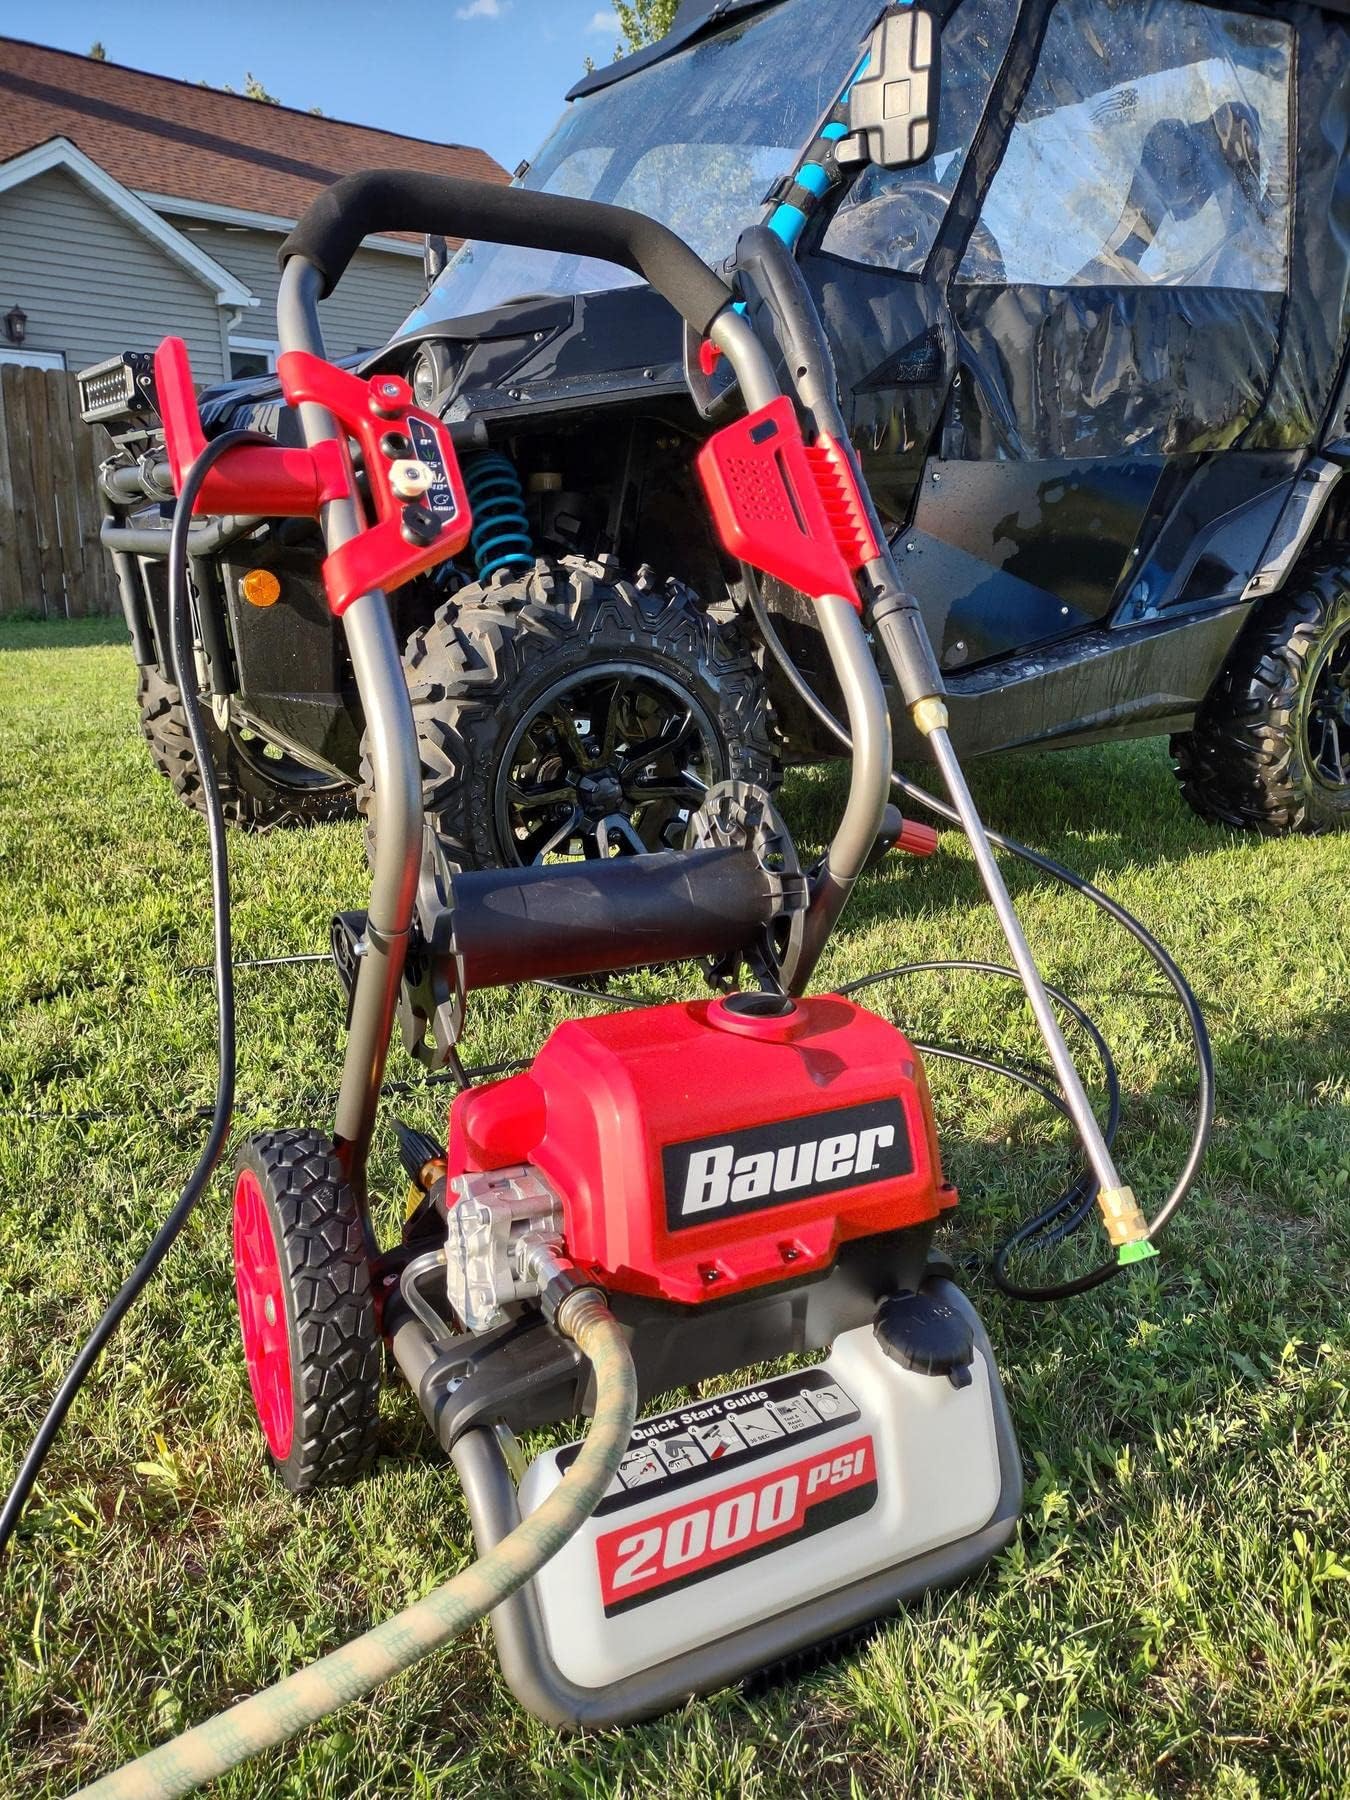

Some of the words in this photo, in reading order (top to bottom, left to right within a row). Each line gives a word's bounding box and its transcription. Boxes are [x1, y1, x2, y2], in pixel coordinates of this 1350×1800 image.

[681, 1125, 895, 1215] Bauer
[631, 1418, 680, 1441] Quick
[680, 1404, 723, 1425] Start
[723, 1391, 769, 1410] Guide
[612, 1475, 800, 1590] 2000
[806, 1448, 866, 1495] PSI
